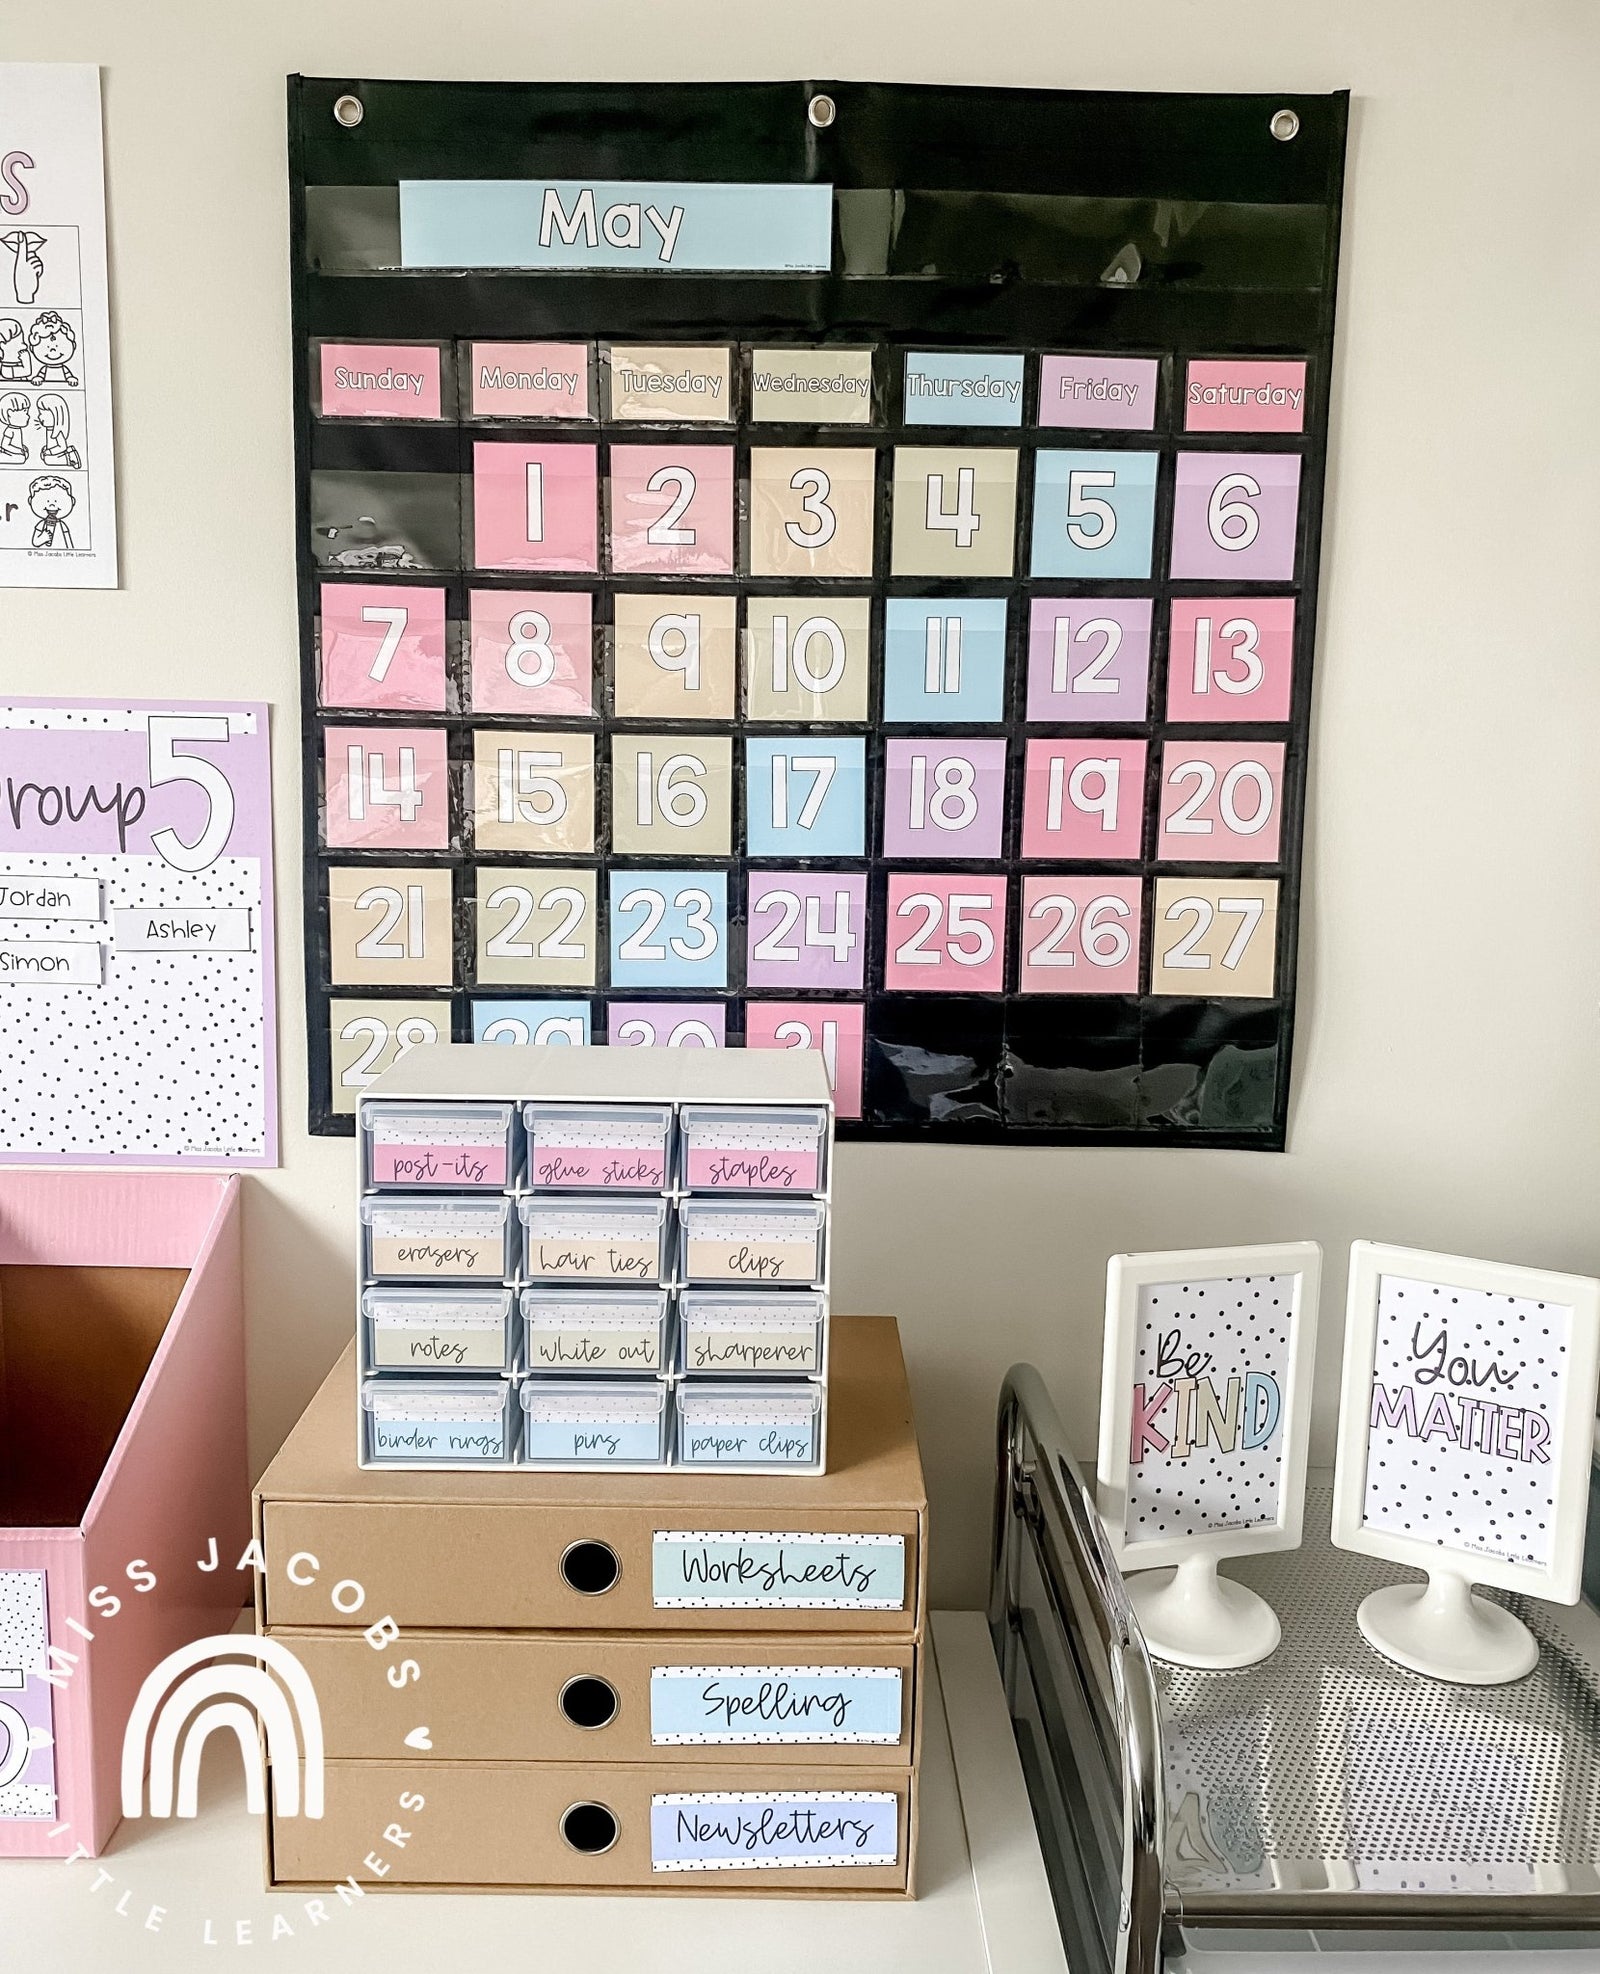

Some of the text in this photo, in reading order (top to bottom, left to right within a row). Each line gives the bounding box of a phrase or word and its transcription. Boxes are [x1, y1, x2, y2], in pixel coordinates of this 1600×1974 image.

[539, 189, 684, 263] May
[335, 367, 1302, 410] Sunday Monday Tuesday Wednesday Thursday Friday Saturday
[526, 462, 1261, 551] 1 2 3 4 5 6
[362, 606, 1264, 694] 7 8 9 10 11 12 13
[0, 715, 235, 873] roup 5
[347, 745, 1273, 835] 14 15 16 17 18 19 20
[0, 887, 70, 906] Jordan
[147, 920, 216, 941] Ashley
[354, 886, 1264, 970] 21 22 23 24 25 26 27
[0, 952, 70, 972] Simon
[393, 1152, 488, 1180] post-its
[539, 1158, 664, 1184] glue sticks
[709, 1158, 797, 1186] staples
[398, 1245, 479, 1268] erasers
[539, 1246, 652, 1276] hair ties
[728, 1247, 784, 1276] clips
[411, 1336, 468, 1363] notes
[539, 1339, 654, 1363] white out
[694, 1340, 813, 1366] sharpener
[1157, 1329, 1213, 1378] Be
[1412, 1322, 1519, 1385] You
[1130, 1372, 1280, 1464] KIND
[1369, 1383, 1551, 1464] MATTER
[377, 1428, 503, 1457] binder rings
[574, 1432, 620, 1455] pins
[691, 1429, 808, 1457] paper clips
[682, 1548, 876, 1592] Worksheets
[702, 1682, 852, 1726] Spelling
[677, 1808, 874, 1849] Newsletters
